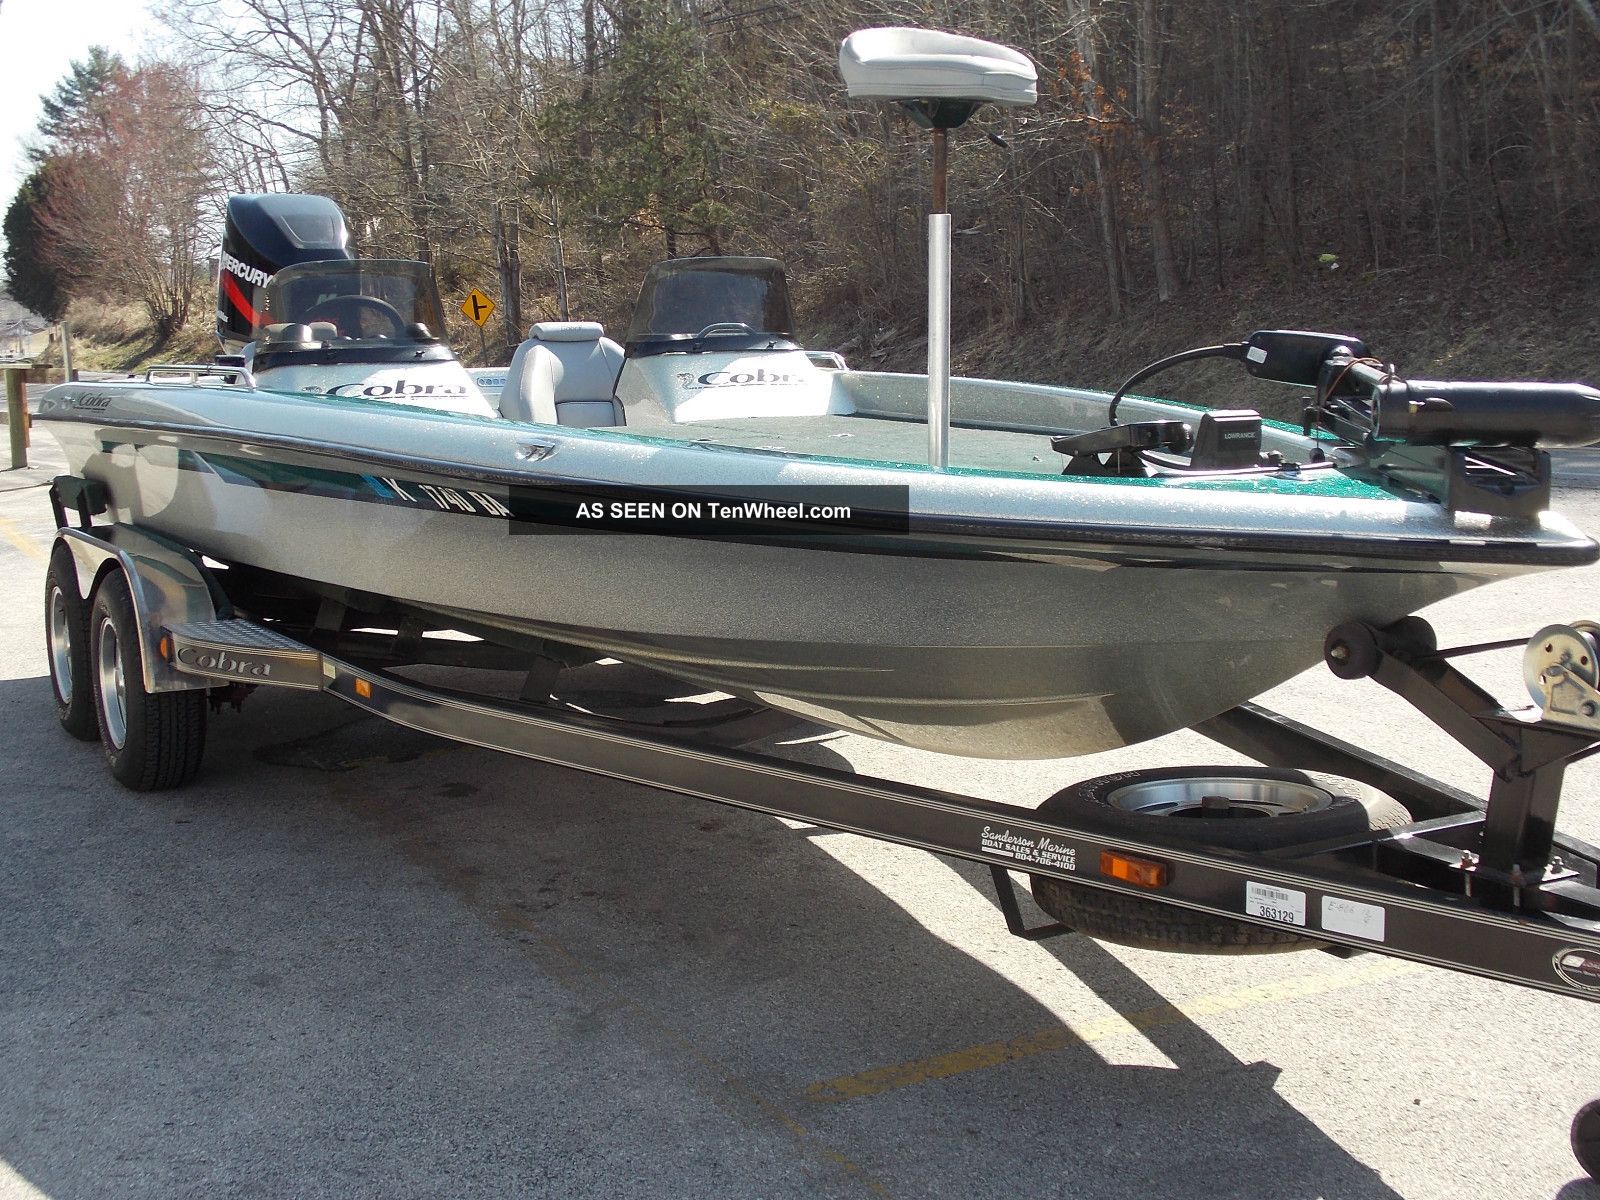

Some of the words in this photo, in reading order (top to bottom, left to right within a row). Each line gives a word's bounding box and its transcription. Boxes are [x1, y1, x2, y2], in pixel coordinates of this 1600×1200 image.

[698, 369, 805, 385] Cobr
[326, 380, 466, 398] Cobra
[79, 392, 112, 408] Cobra
[1224, 431, 1256, 440] LOWRANCE
[178, 647, 271, 676] Cobra
[981, 826, 1035, 848] Sanderson
[1037, 837, 1076, 856] Marine
[981, 838, 1004, 848] BOAT
[1005, 843, 1031, 854] SALES
[1041, 850, 1076, 864] SERVICE
[1014, 852, 1076, 871] 804-706-4100
[1259, 905, 1294, 923] 363129
